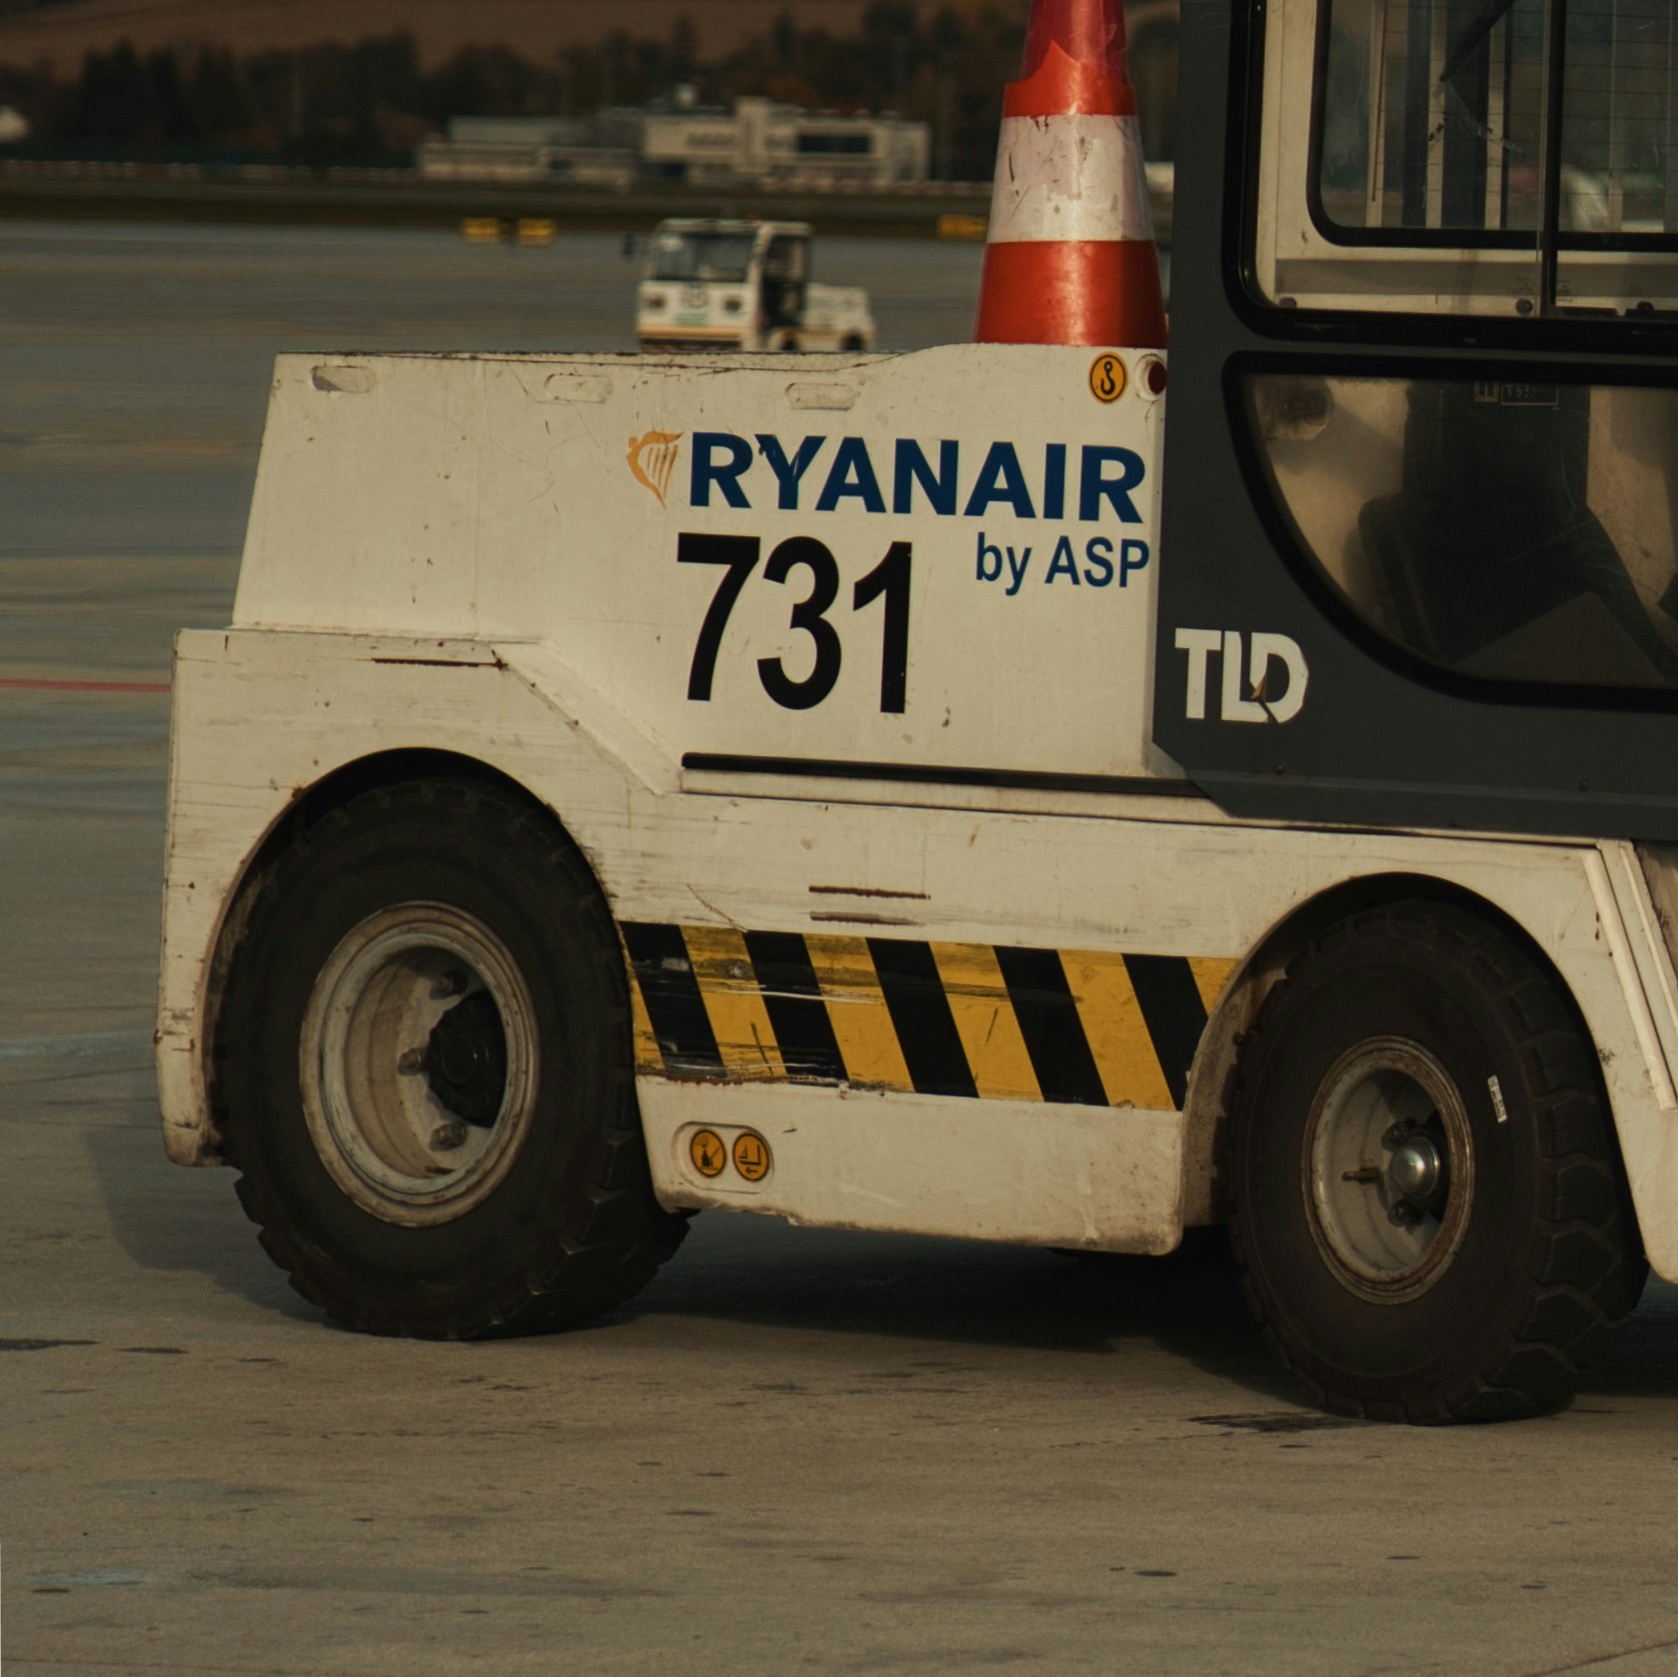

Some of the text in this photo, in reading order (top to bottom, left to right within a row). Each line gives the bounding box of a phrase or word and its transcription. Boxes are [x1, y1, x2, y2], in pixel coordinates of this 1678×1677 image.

[690, 432, 1146, 524] RYANAIR
[976, 532, 1150, 596] by ASP
[677, 532, 912, 715] 731
[1175, 628, 1309, 723] TLD
